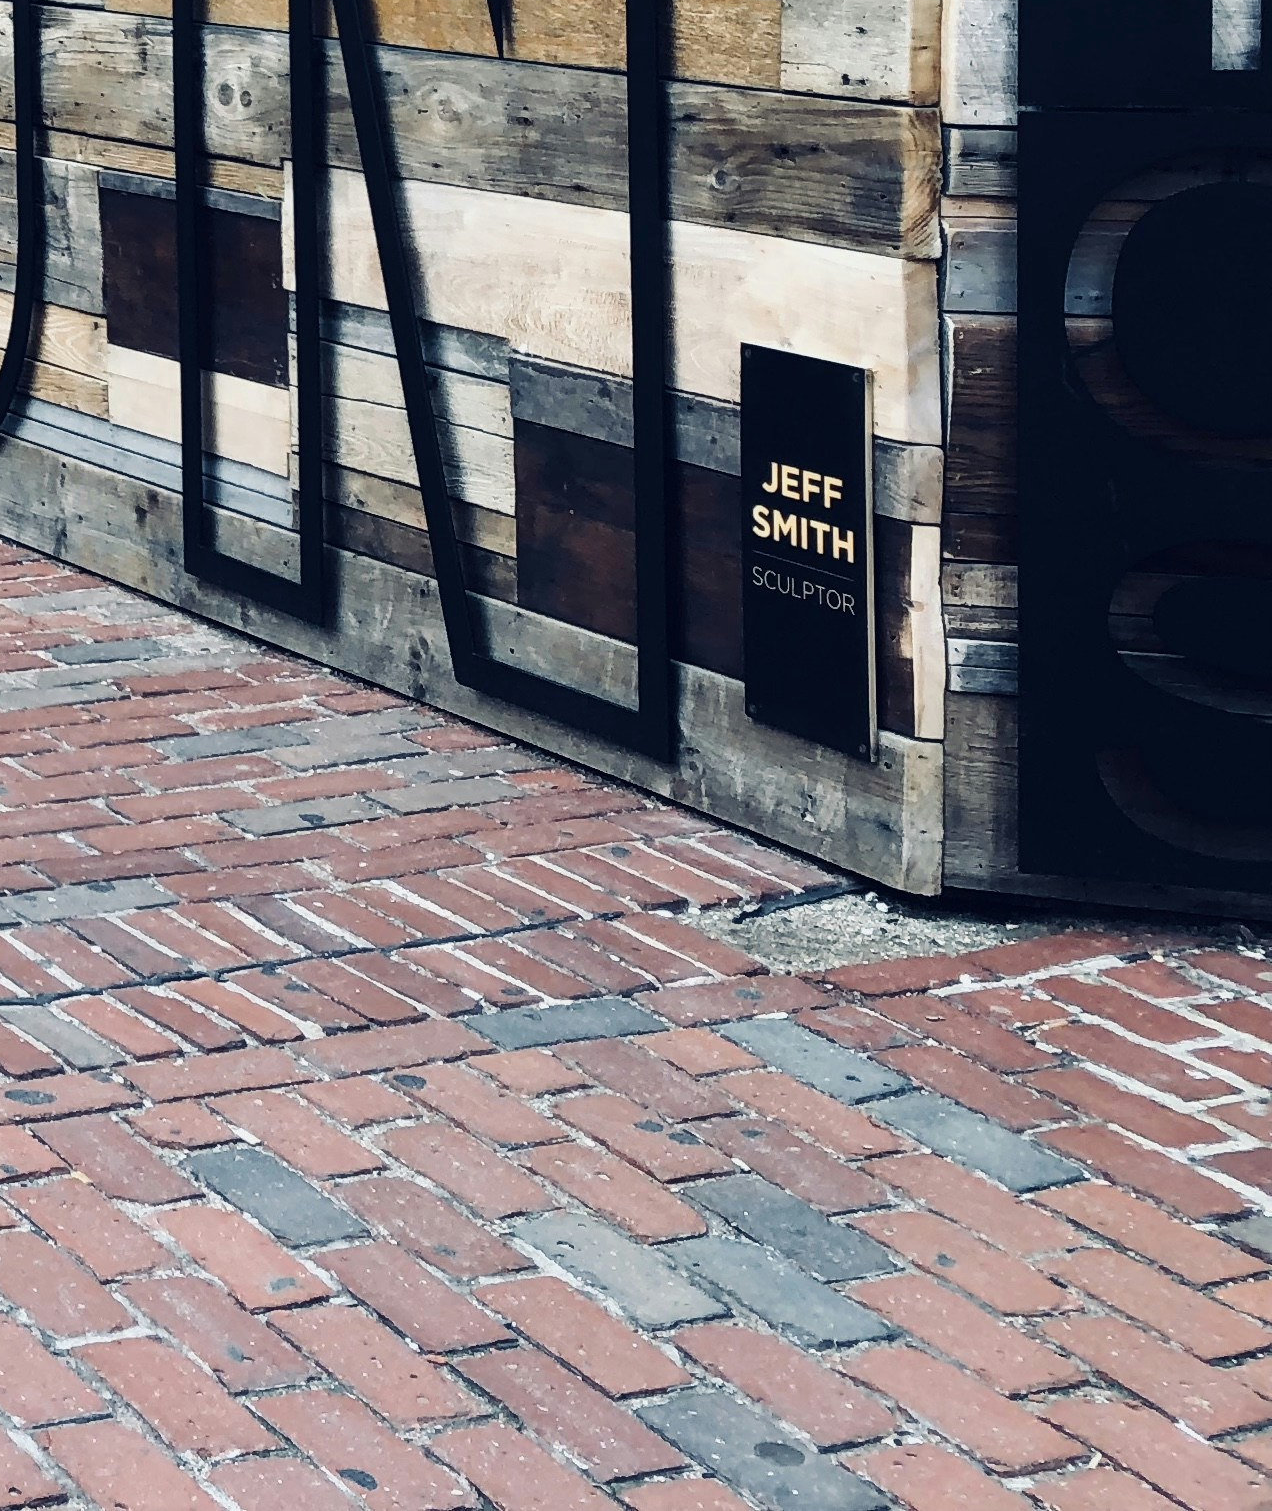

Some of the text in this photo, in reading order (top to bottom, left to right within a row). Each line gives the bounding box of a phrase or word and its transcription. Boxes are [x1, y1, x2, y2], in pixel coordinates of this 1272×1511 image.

[762, 461, 843, 509] JEFF
[752, 505, 855, 564] SMITH
[752, 565, 856, 616] SCULPTOR
